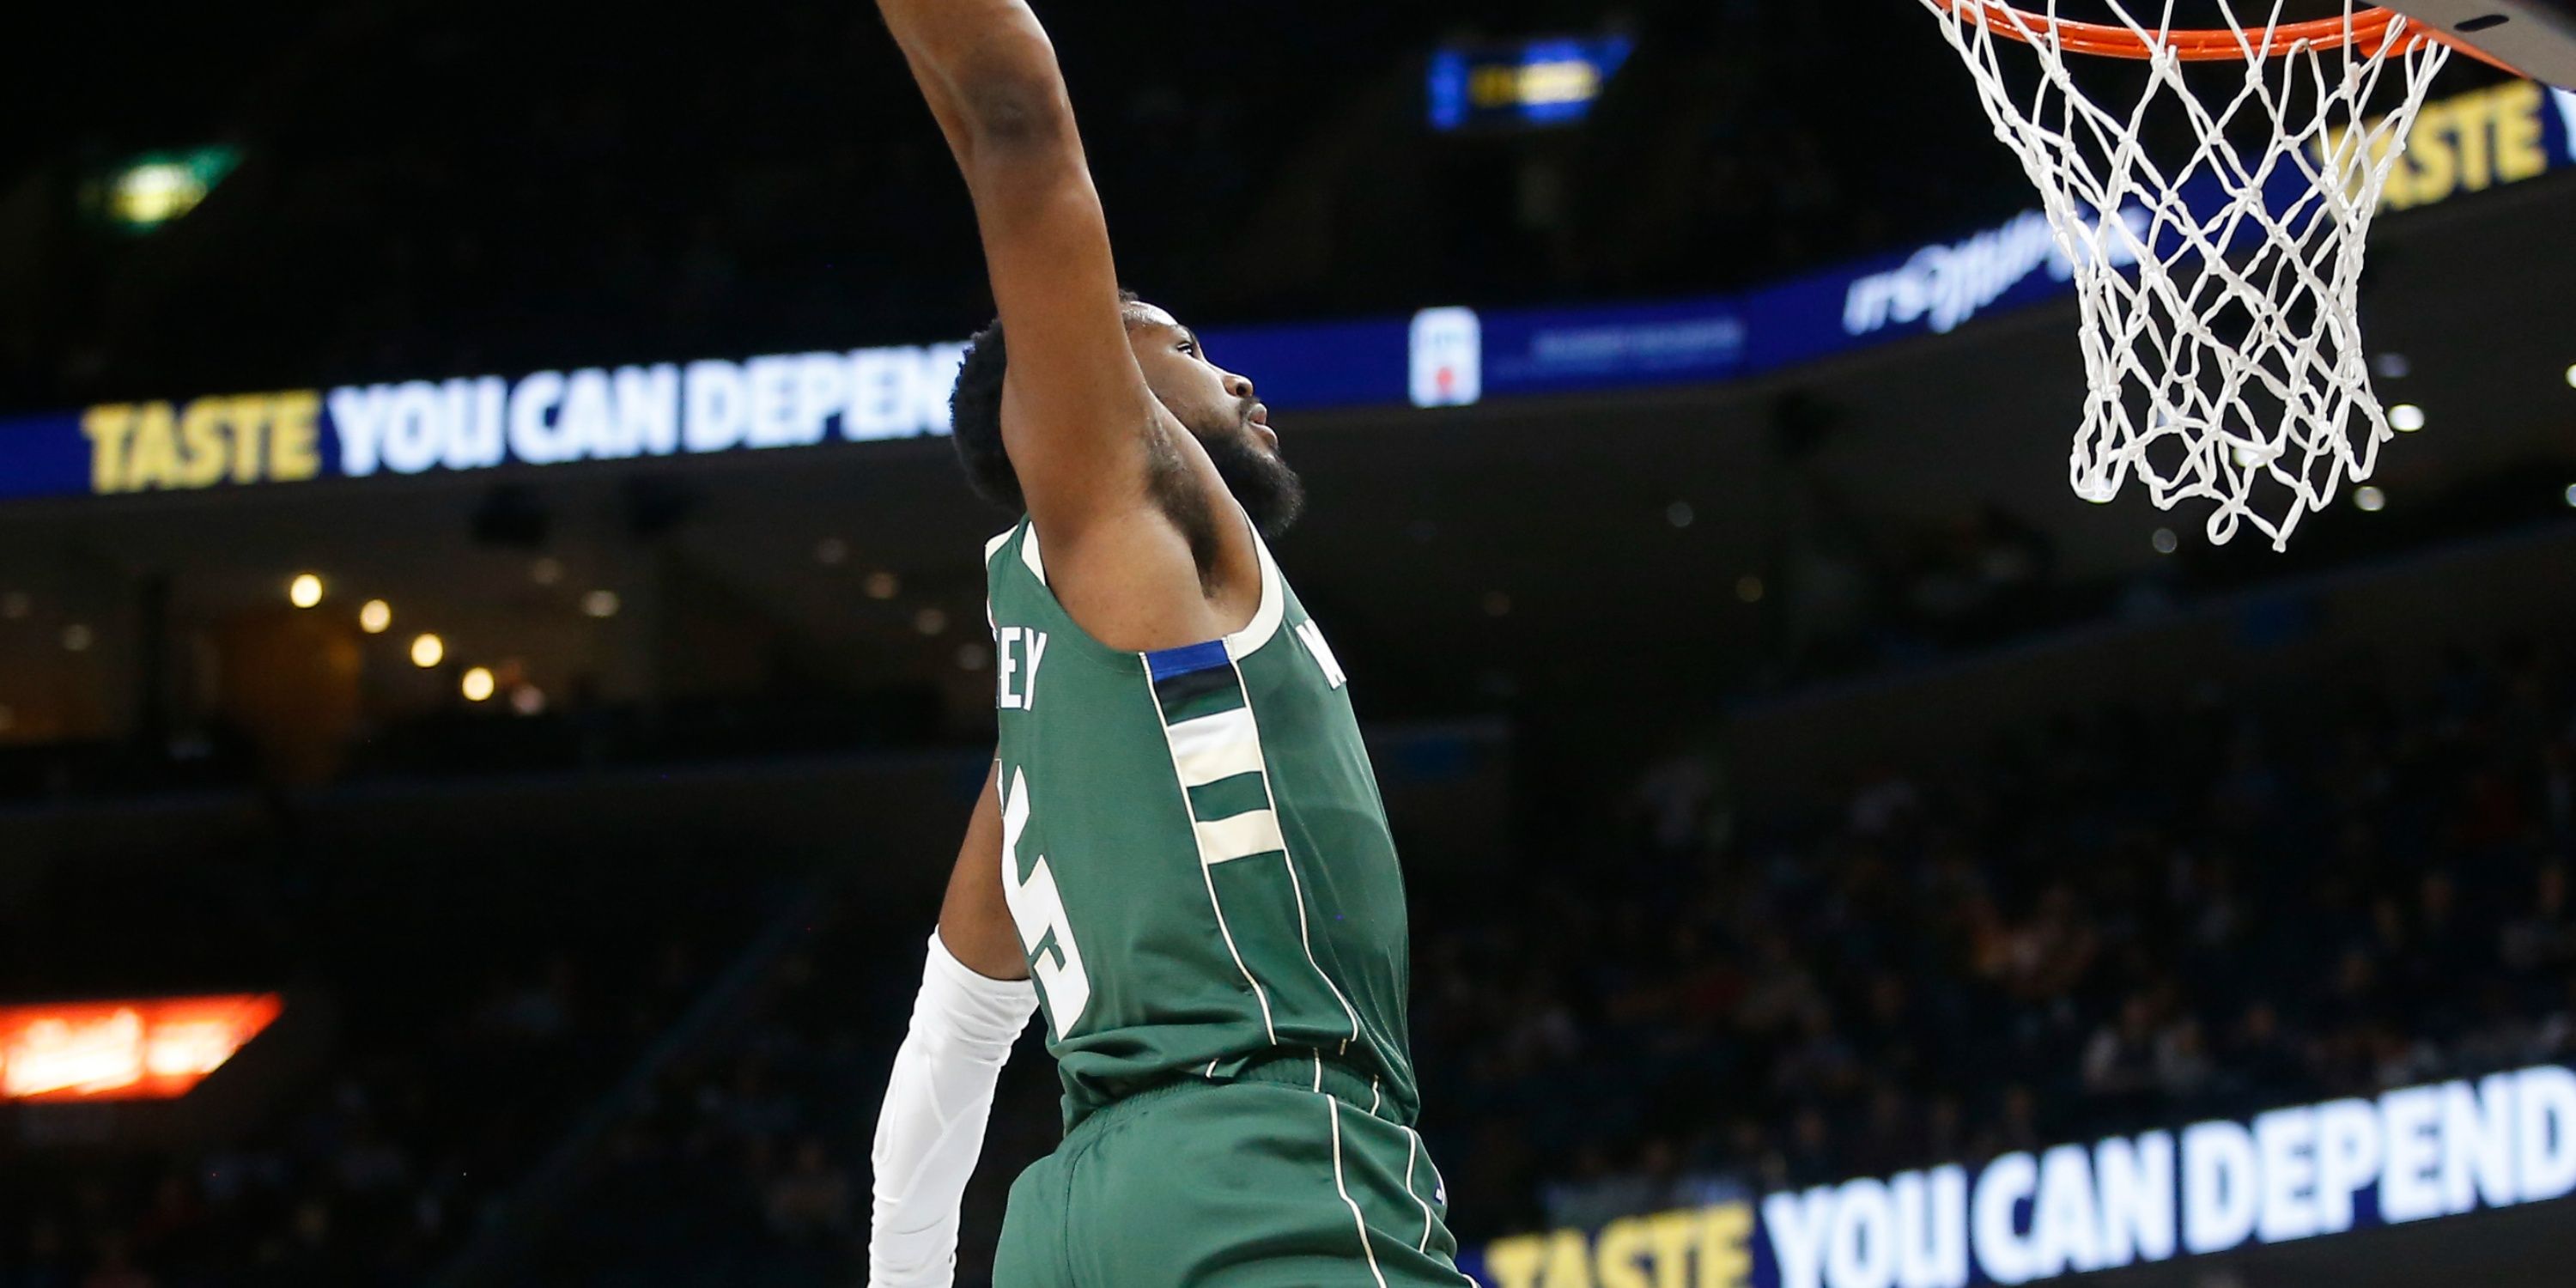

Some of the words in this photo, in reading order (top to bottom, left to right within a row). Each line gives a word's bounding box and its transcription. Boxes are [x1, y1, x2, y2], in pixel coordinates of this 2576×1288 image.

[82, 389, 321, 495] TASTE
[328, 374, 508, 477] YOU
[508, 362, 680, 465] CAN
[1482, 1200, 1753, 1288] TASTE
[1763, 1163, 1971, 1288] YOU
[1972, 1128, 2176, 1285] CAN
[2180, 1064, 2576, 1255] DEPEND
